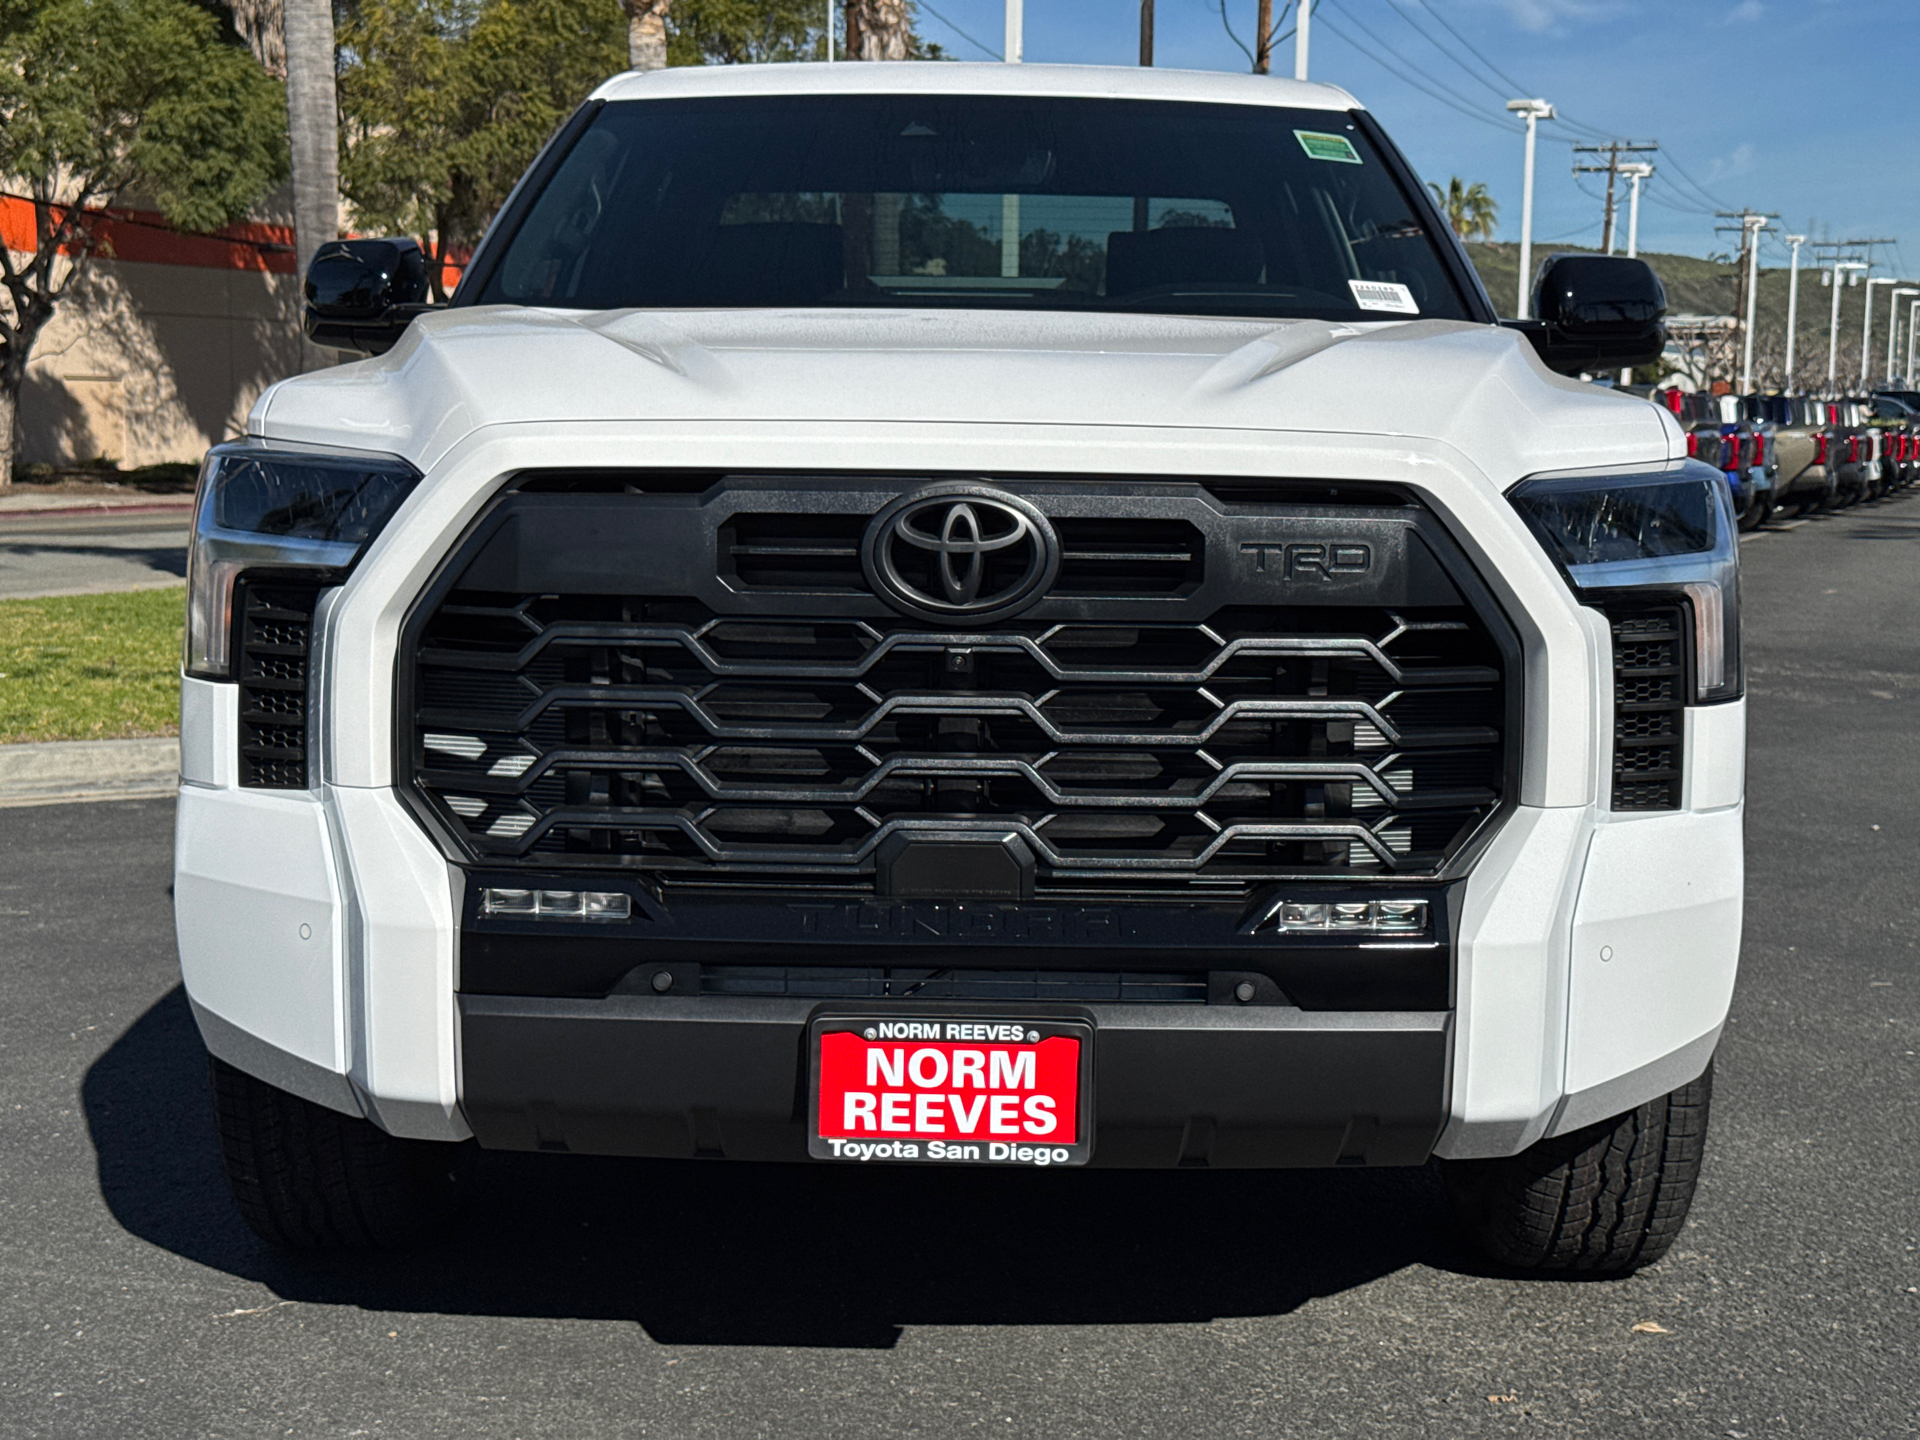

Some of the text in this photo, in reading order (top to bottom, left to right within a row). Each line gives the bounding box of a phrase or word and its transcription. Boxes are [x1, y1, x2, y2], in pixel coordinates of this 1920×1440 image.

[1240, 543, 1370, 581] TRD
[879, 1023, 1024, 1042] NORM REEVES
[866, 1048, 1036, 1090] NORM
[843, 1091, 1058, 1135] REEVES
[827, 1138, 1069, 1166] Toyota San Diego
